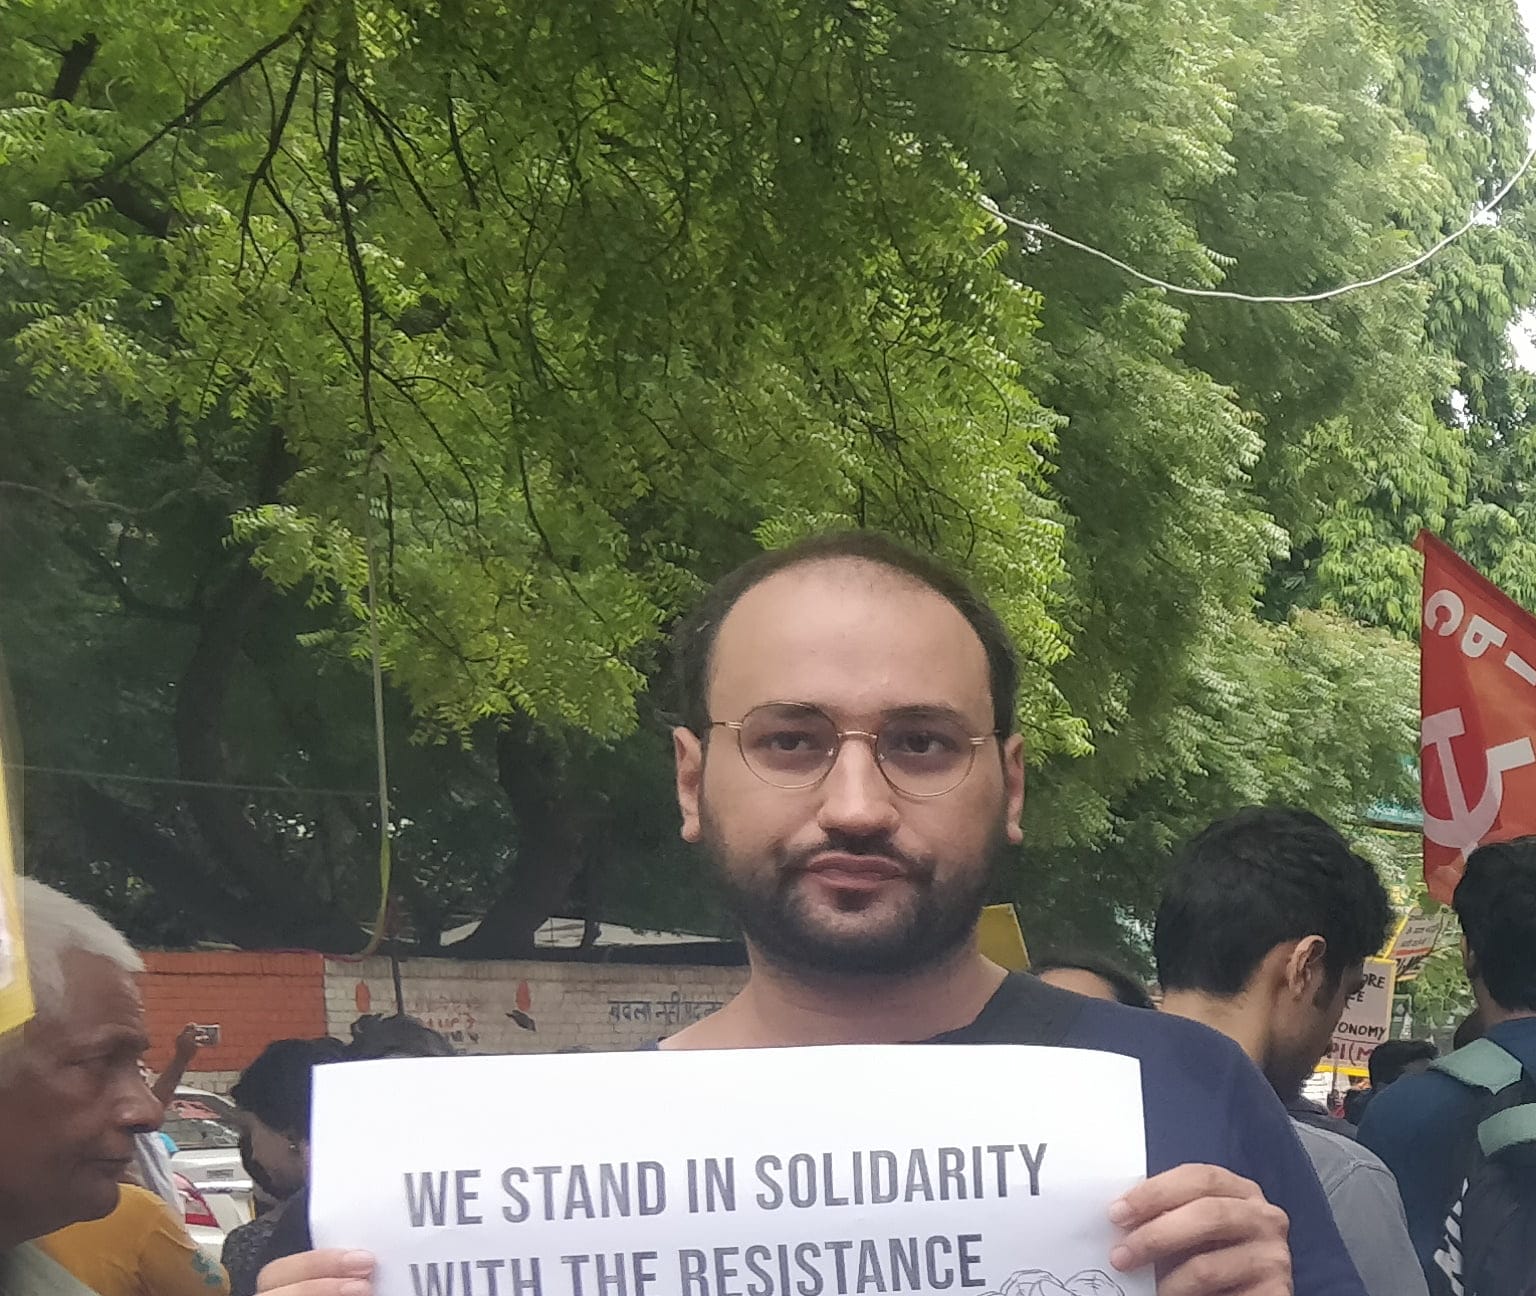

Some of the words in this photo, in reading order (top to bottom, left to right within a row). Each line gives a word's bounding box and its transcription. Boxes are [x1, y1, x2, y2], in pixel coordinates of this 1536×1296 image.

[404, 1169, 483, 1227] WE
[501, 1160, 667, 1222] STAND
[687, 1155, 736, 1213] IN
[756, 1143, 1047, 1210] SOLIDARITY
